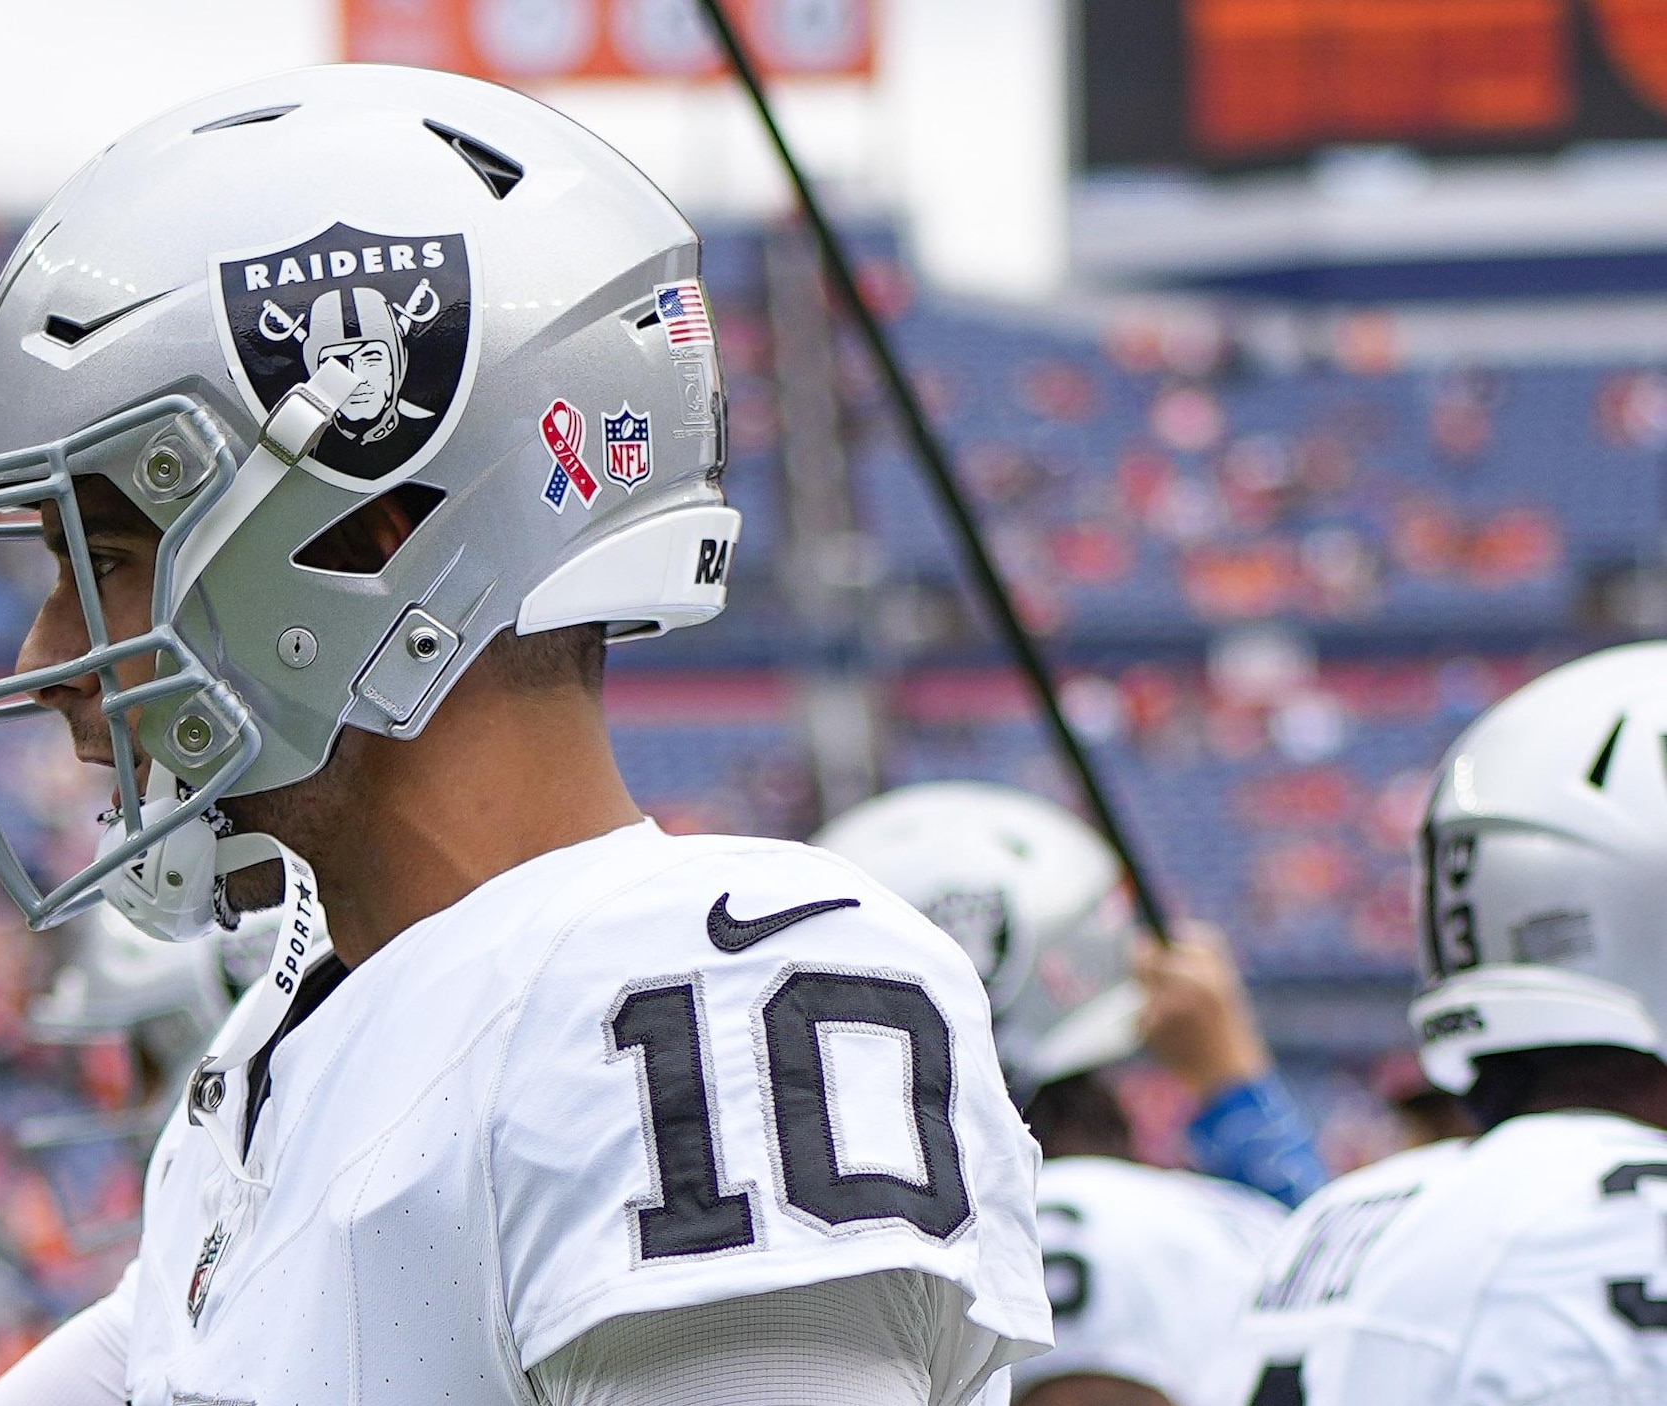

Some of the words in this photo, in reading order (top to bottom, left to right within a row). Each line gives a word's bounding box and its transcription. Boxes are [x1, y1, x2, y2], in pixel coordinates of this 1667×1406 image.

[245, 241, 446, 291] RAIDERS
[553, 439, 579, 475] 9/11
[609, 443, 647, 479] NFL
[275, 901, 312, 995] SPORT
[605, 965, 977, 1266] 10
